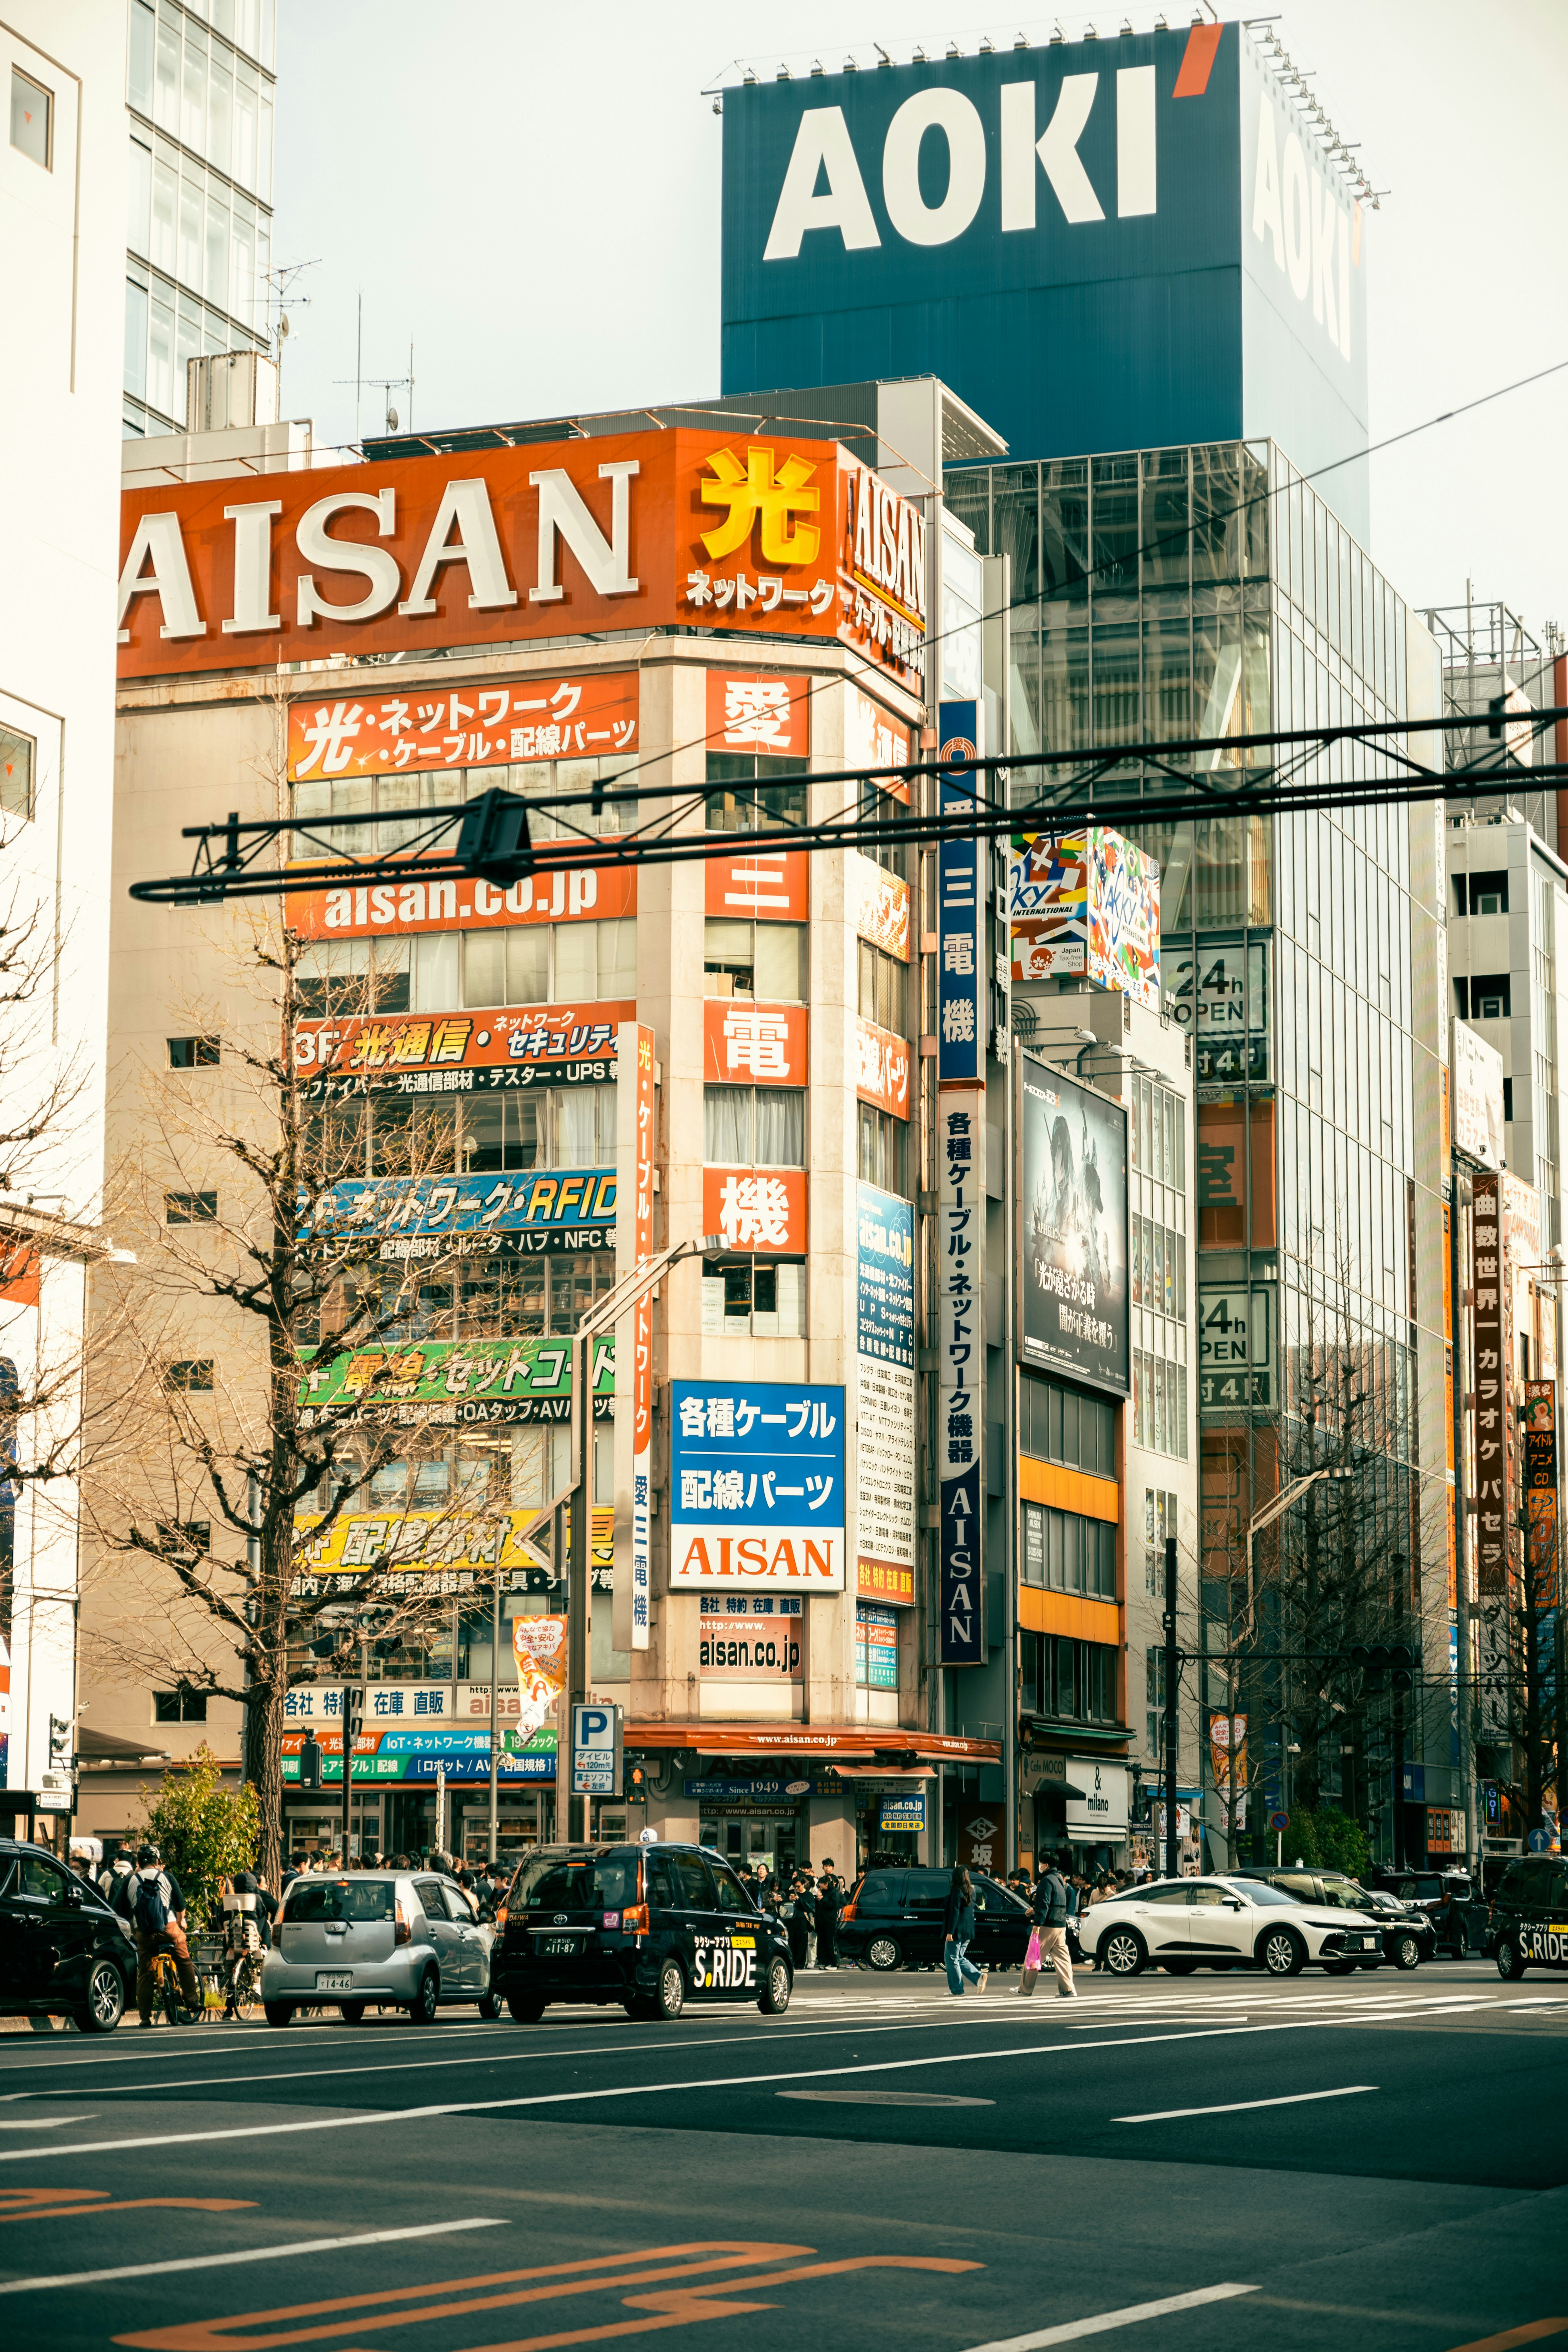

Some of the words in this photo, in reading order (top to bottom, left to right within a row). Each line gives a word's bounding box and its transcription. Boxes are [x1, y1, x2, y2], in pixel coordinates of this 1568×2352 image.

[700, 446, 821, 564] 光
[118, 460, 640, 643] AISAN
[855, 466, 926, 616] AISAN
[686, 570, 834, 615] ネットワーク
[324, 866, 597, 928] aisan.co.jp
[1013, 906, 1073, 917] INTERNATIONAL
[1121, 925, 1145, 946] INTERNATIONAL
[1176, 959, 1243, 997] 24h
[493, 1011, 575, 1032] ネットワーク
[1174, 1001, 1243, 1023] OPEN
[296, 1030, 341, 1066] 3F
[860, 1212, 912, 1268] aisan.co.jp
[946, 1111, 973, 1464] 各種ケーブル・ネットワーク機器
[1528, 1384, 1552, 1398] 激安
[679, 1396, 836, 1439] 各種ケーブル
[1529, 1434, 1553, 1448] アイドル
[1530, 1453, 1553, 1467] アニメ
[1534, 1473, 1549, 1486] CD
[680, 1470, 834, 1511] 配線パーツ
[634, 1475, 648, 1627] 愛三電機
[679, 1537, 833, 1577] AISAN
[948, 1487, 973, 1644] AISAN
[860, 1563, 870, 1586] 各社
[873, 1566, 884, 1589] 特約
[887, 1569, 898, 1592] 在庫
[900, 1571, 912, 1593] 直販
[700, 1597, 720, 1613] 各社
[726, 1597, 747, 1614] 特約
[753, 1597, 774, 1614] 在庫
[780, 1598, 800, 1615] 直販
[519, 1634, 555, 1643] 安全・安心
[700, 1634, 799, 1673] aisan.co.jp
[374, 1691, 404, 1716] 在庫
[414, 1691, 444, 1715] 直販
[581, 1712, 607, 1745] P
[757, 1735, 837, 1747] www.aisan.co.jp
[377, 1760, 398, 1773] 配線
[423, 1759, 464, 1772] ロボット
[578, 1753, 610, 1761] ダイビル
[1030, 1760, 1041, 1773] Cafe
[1043, 1760, 1063, 1774] MOCO
[577, 1773, 611, 1781] 富士ソフト
[750, 1781, 779, 1793] 1949
[1095, 1766, 1102, 1791] &
[883, 1800, 922, 1812] aisan.co.jp
[1088, 1793, 1109, 1812] milano
[1520, 1923, 1548, 1932] タクシーアプリ
[552, 1944, 575, 1953] 11-87
[694, 1935, 731, 1948] タクシーアプリ
[1519, 1932, 1568, 1961] S.RIDE
[694, 1949, 757, 1987] S.RIDE
[326, 1979, 350, 1989] 14-46
